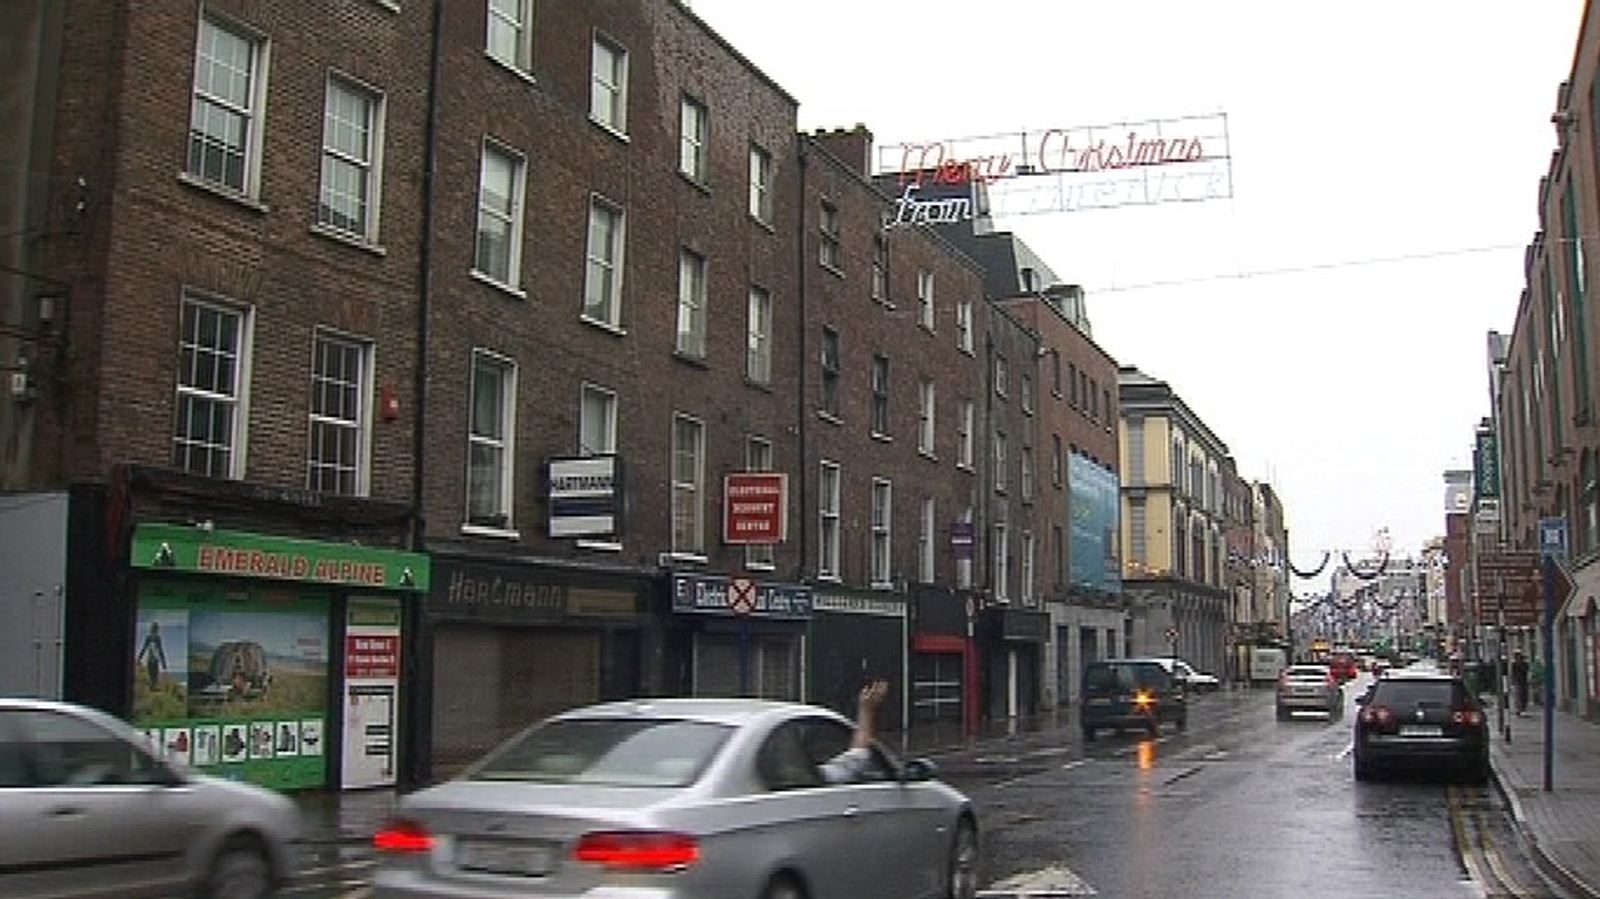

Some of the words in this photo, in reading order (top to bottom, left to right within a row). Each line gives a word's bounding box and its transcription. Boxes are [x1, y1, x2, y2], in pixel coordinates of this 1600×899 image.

[899, 141, 1012, 187] Merry
[1039, 128, 1204, 172] Christmas
[886, 184, 973, 228] from
[197, 545, 310, 577] EMERALD
[314, 558, 387, 585] ALPINE
